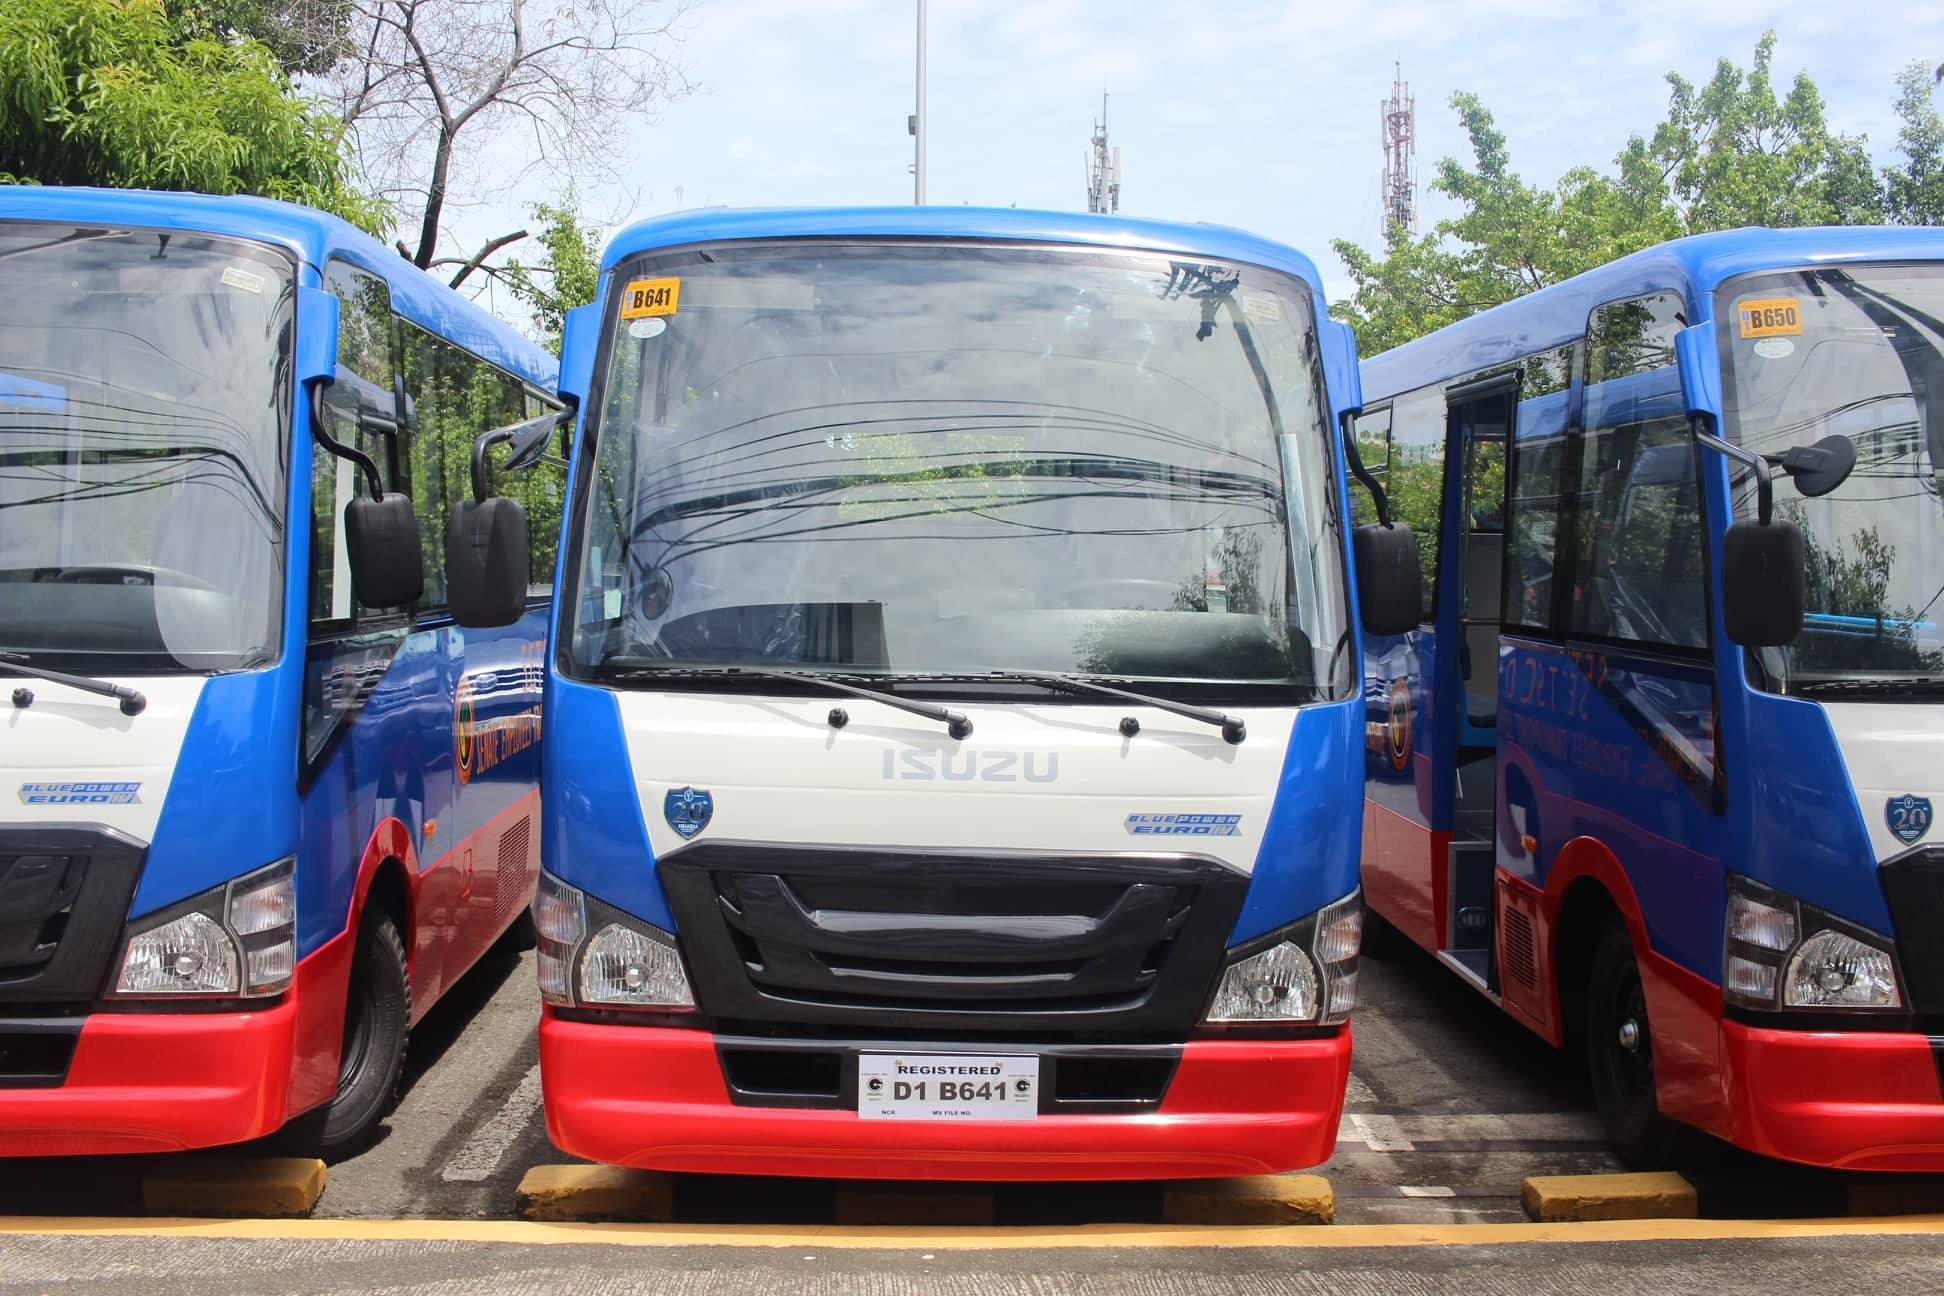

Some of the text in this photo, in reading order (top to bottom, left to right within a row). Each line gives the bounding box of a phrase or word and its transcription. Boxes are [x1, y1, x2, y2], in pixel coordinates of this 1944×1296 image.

[633, 287, 672, 309] B641
[1750, 307, 1797, 328] B650
[882, 749, 1058, 783] ISUZU
[22, 783, 138, 793] BLUEPOWER
[27, 795, 110, 803] EURO
[1128, 815, 1239, 824] BLUEPOWER
[1894, 808, 1926, 829] 20
[898, 1065, 1001, 1075] REGISTERED
[894, 1081, 1006, 1101] D1 B641
